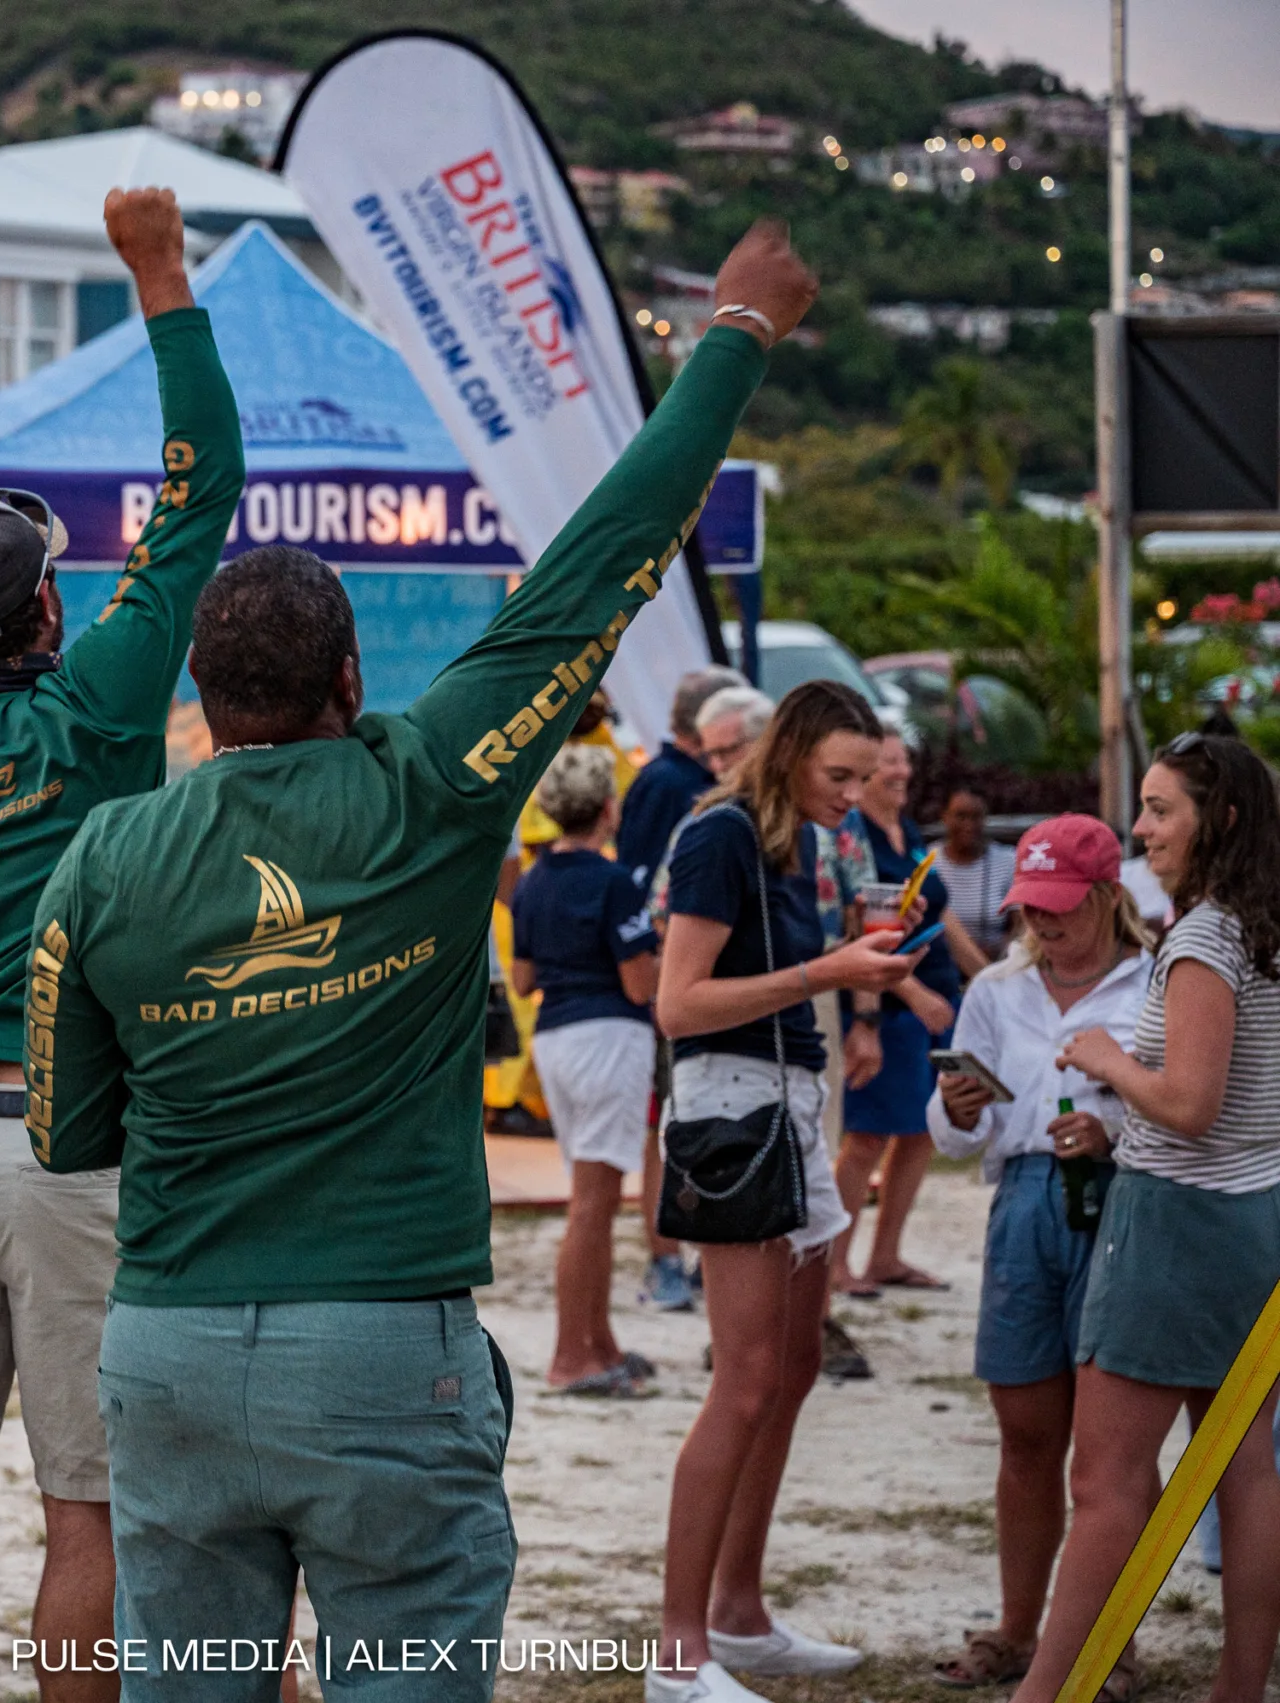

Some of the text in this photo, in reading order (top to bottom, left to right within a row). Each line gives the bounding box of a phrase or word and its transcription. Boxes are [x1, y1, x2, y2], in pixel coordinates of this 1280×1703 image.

[352, 192, 512, 443] BVITOURISM.COM
[440, 149, 590, 400] BRITISH
[139, 936, 437, 1023] BAD DECISIONS
